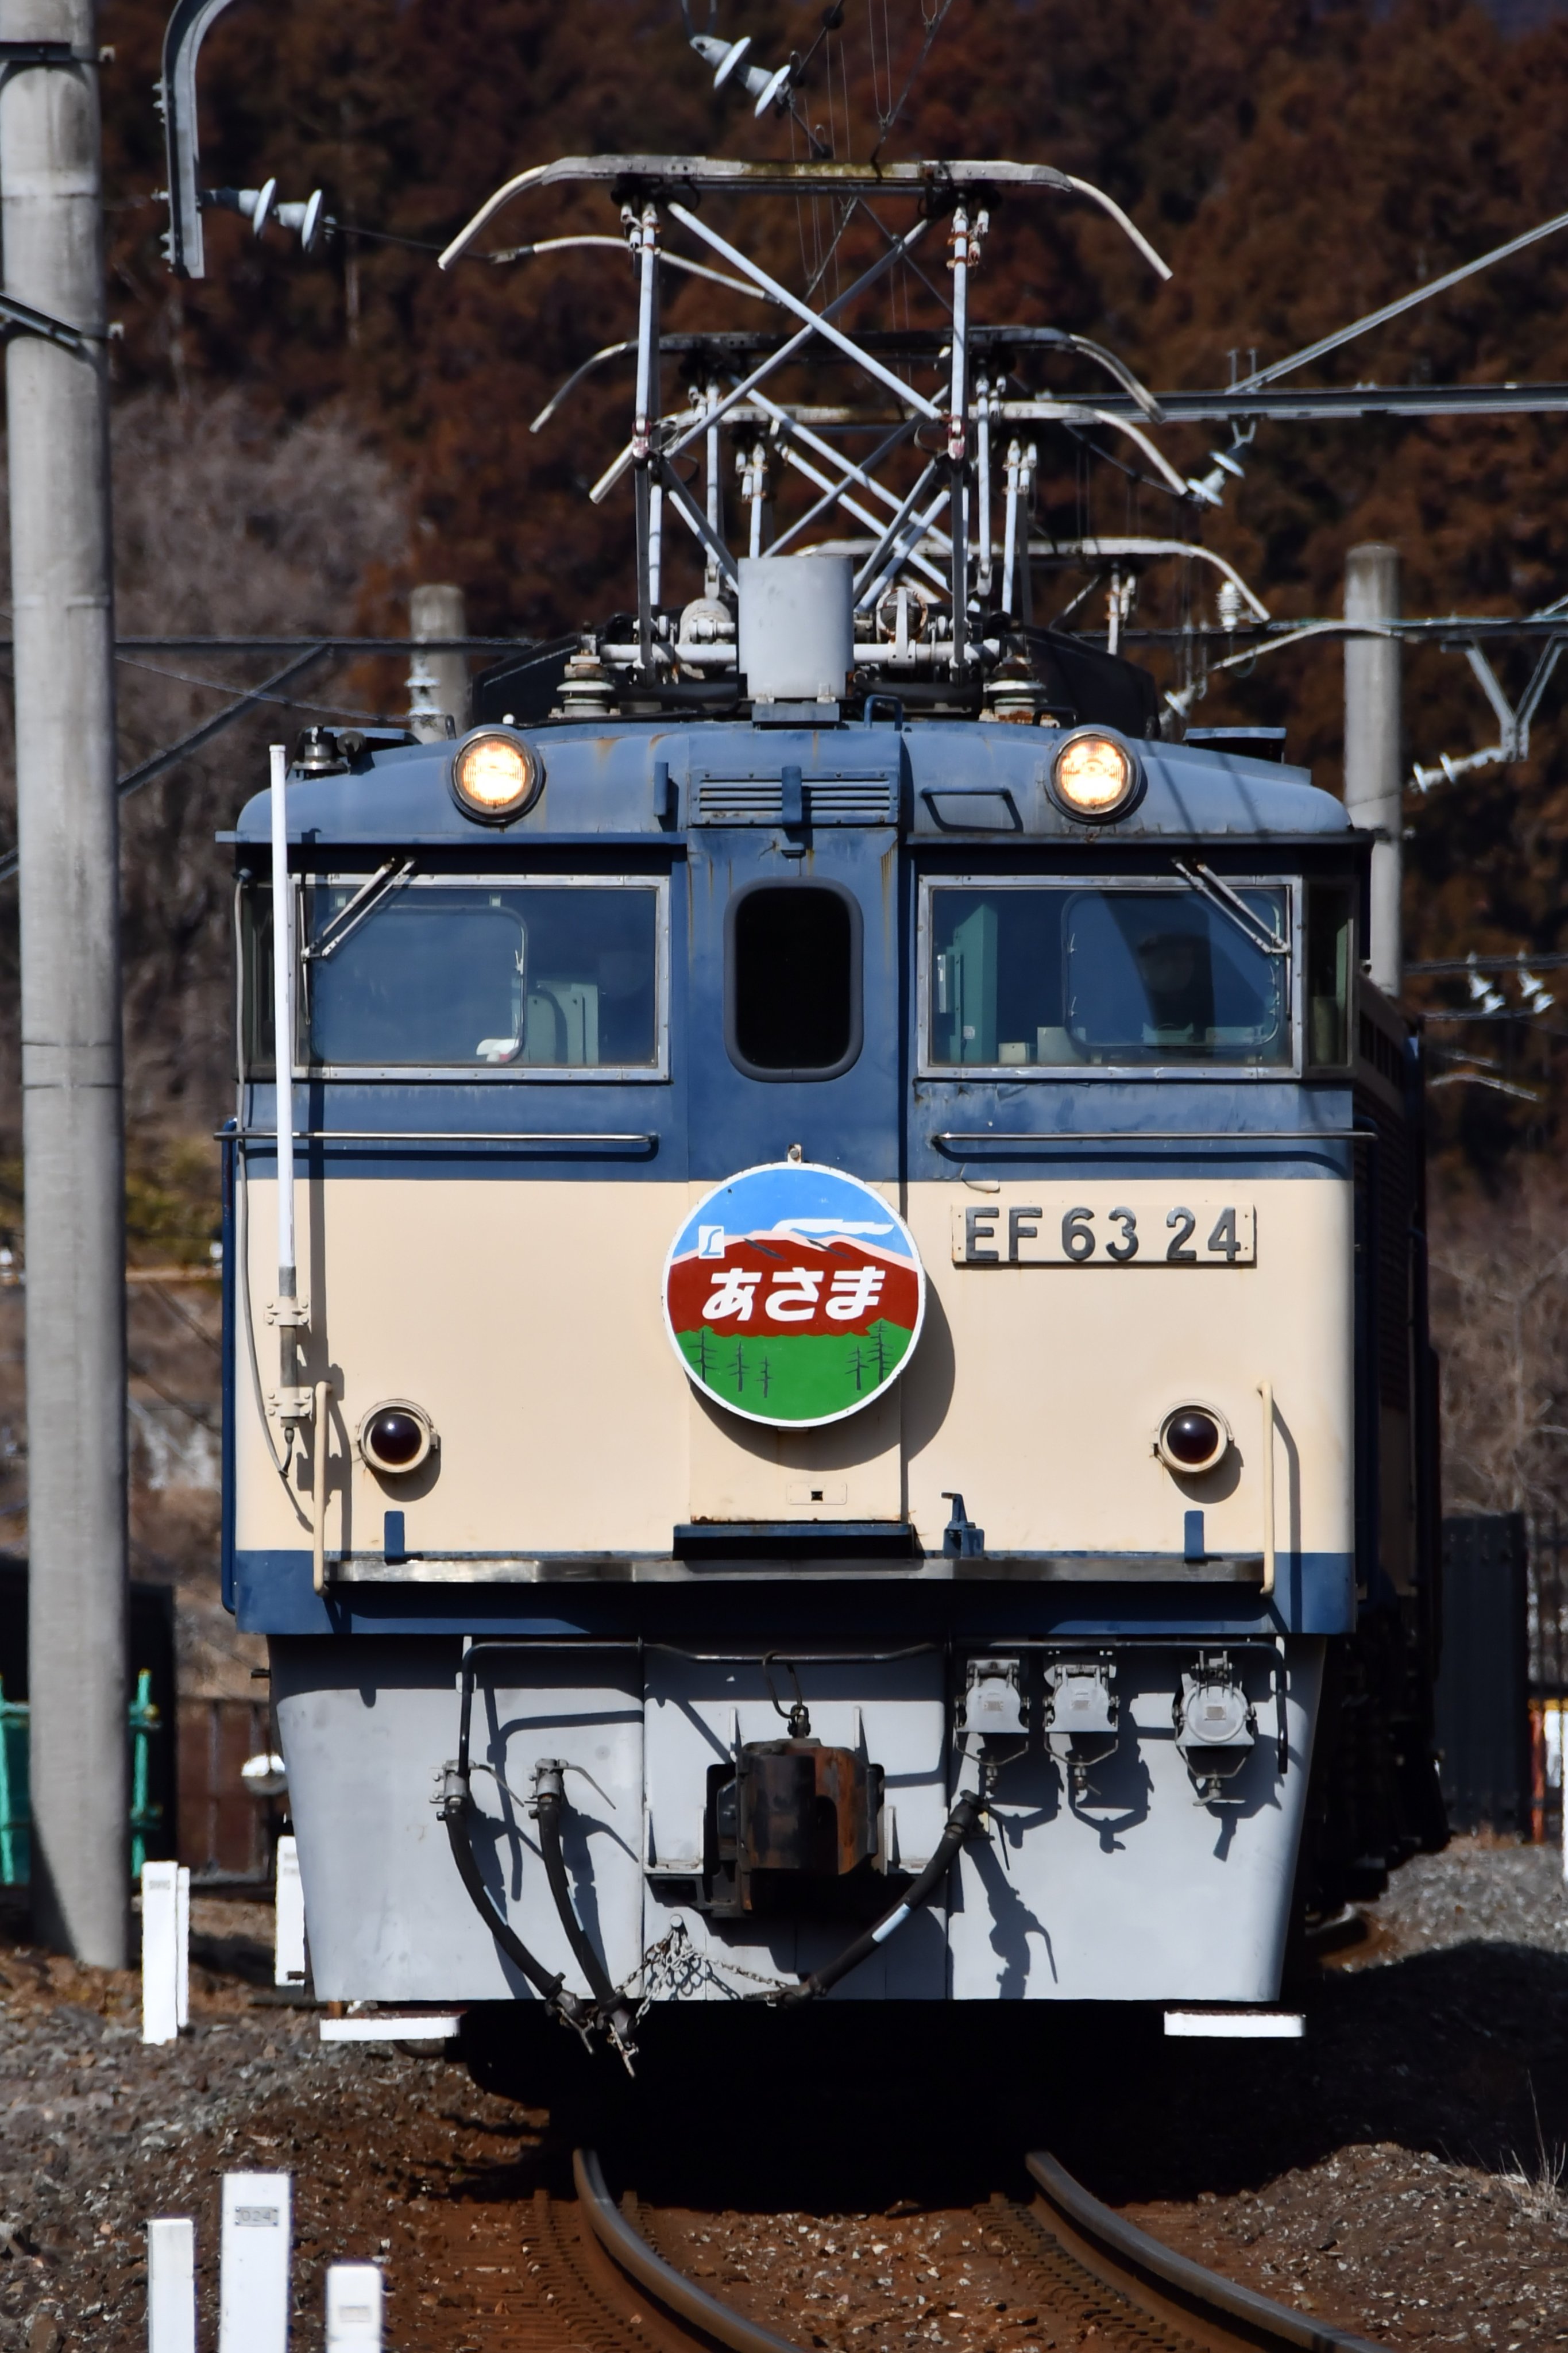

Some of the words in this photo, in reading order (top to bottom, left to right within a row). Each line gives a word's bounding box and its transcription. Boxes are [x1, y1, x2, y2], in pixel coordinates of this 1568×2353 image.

[1166, 1206, 1241, 1262] 24
[702, 1266, 886, 1322] あさま
